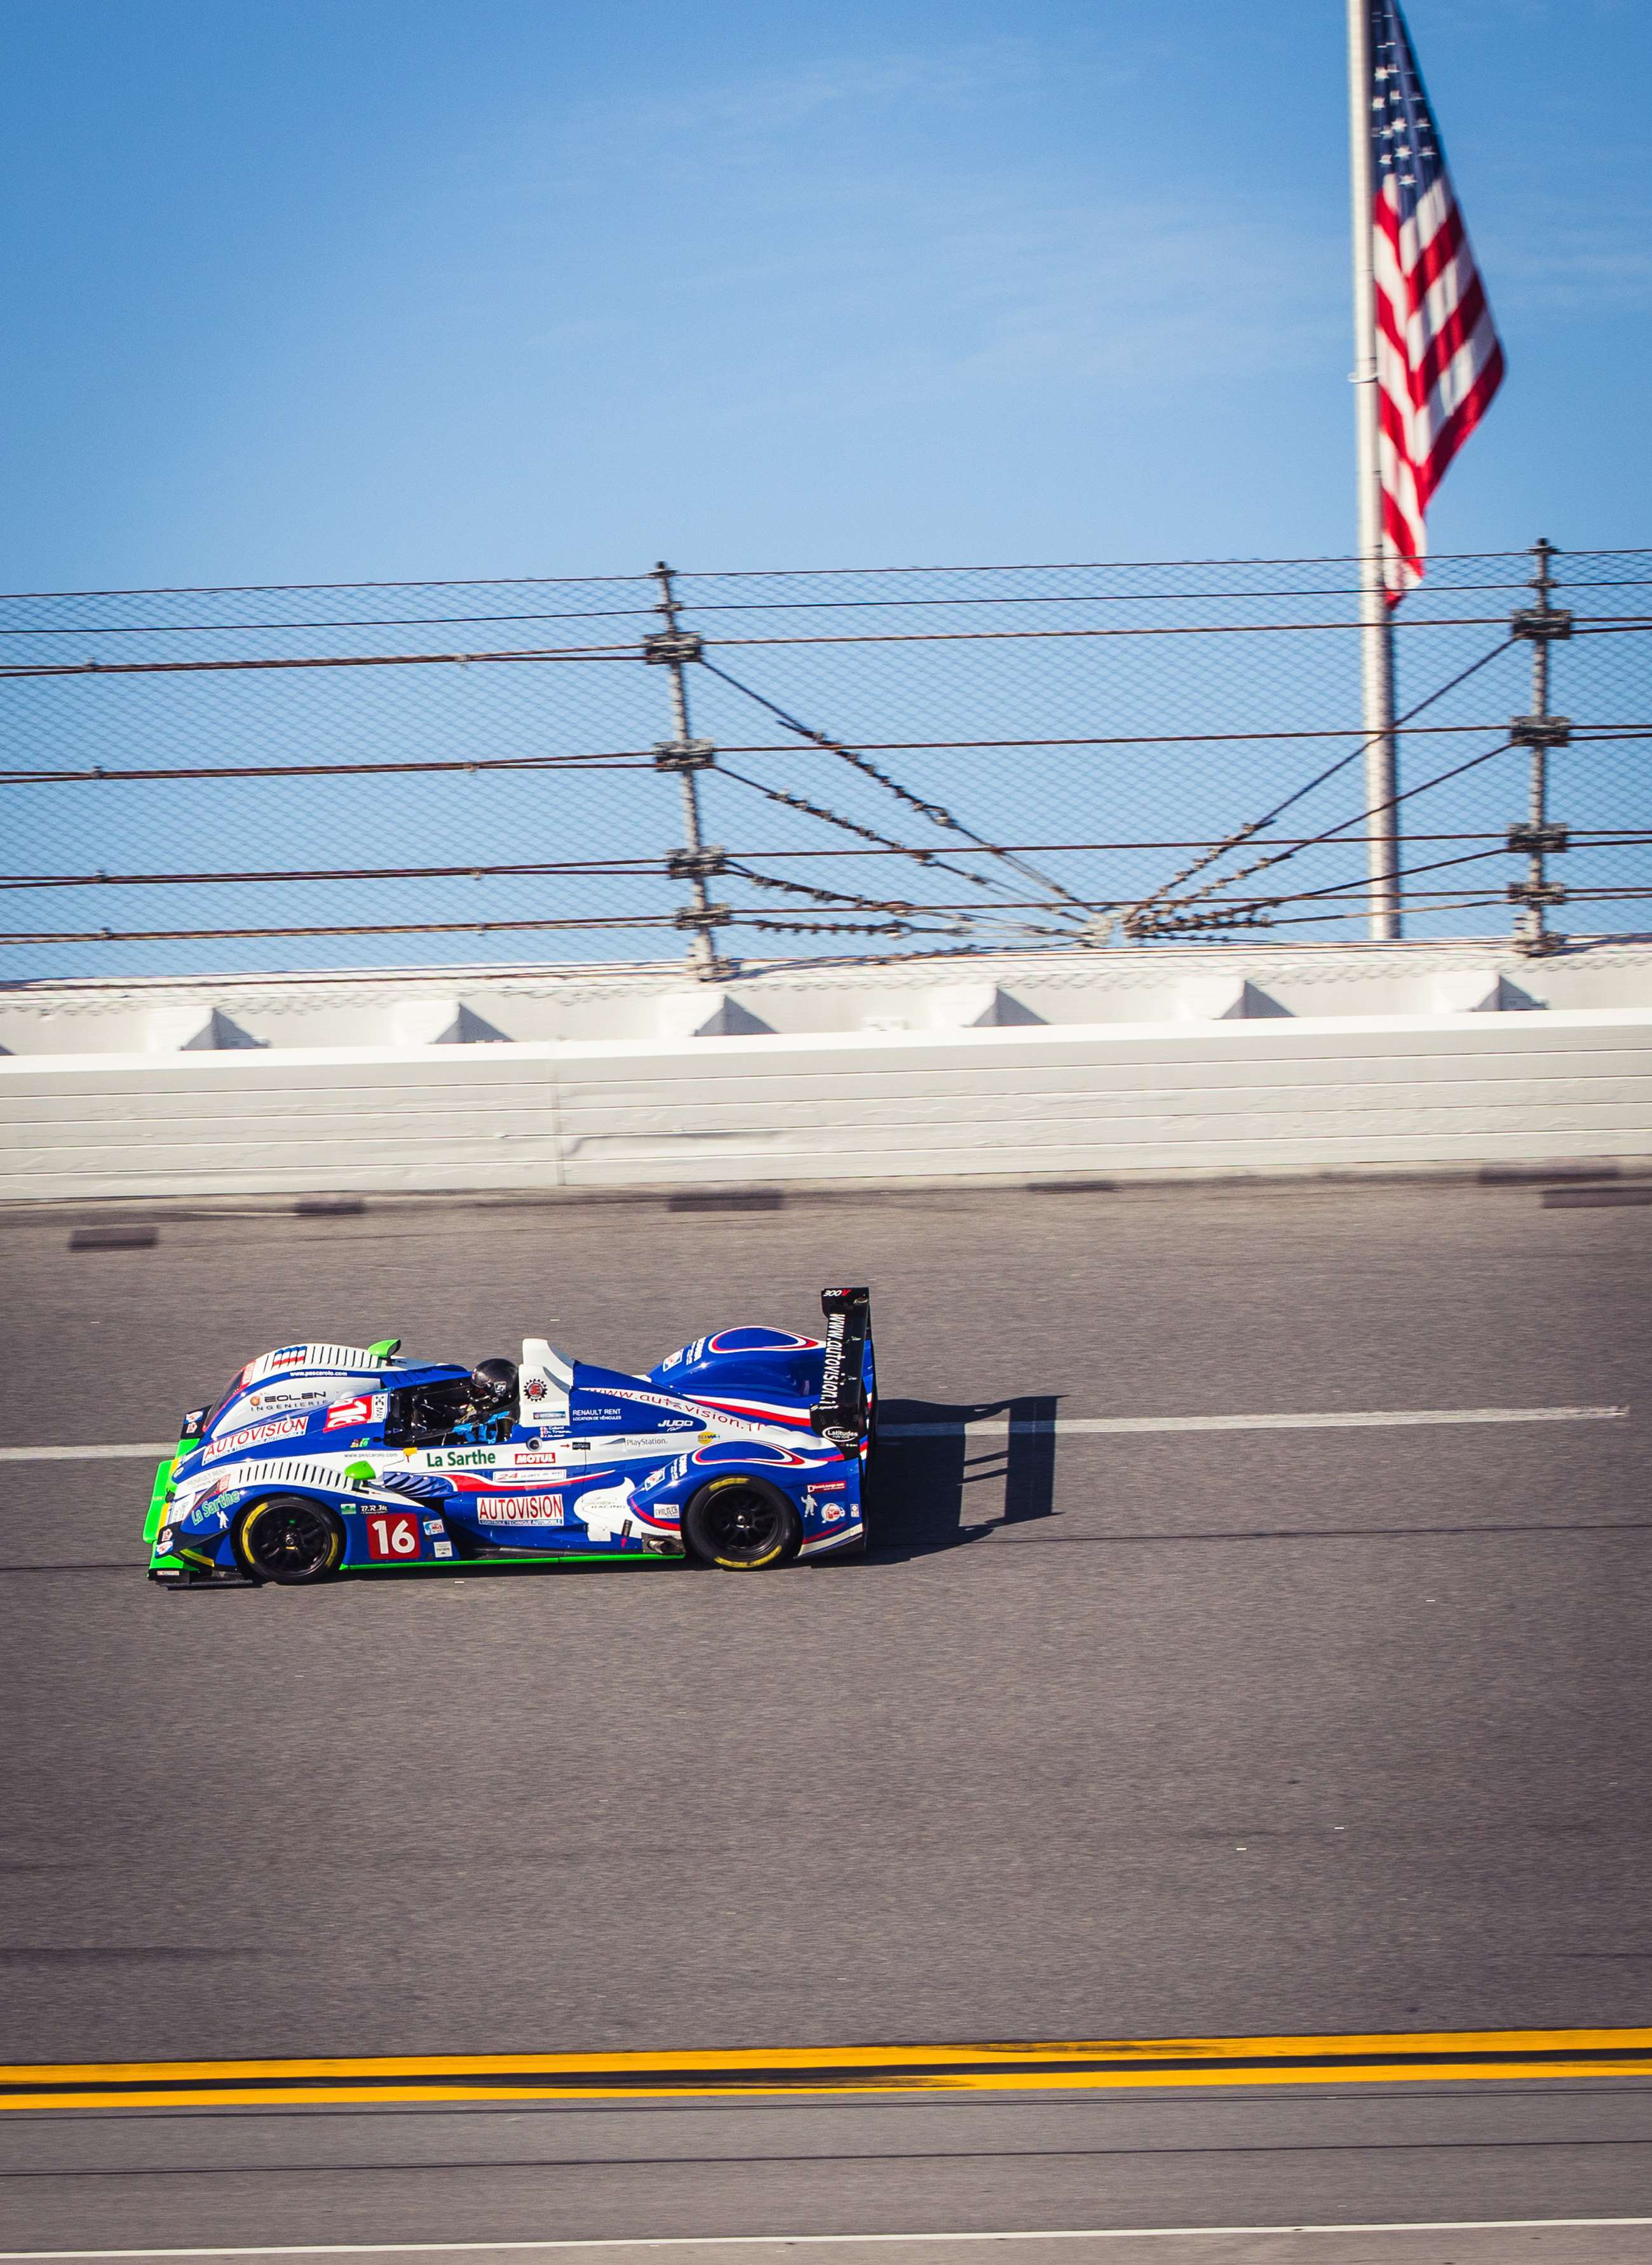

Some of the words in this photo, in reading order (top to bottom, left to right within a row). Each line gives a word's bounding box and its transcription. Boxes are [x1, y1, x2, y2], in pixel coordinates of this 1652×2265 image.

[264, 1391, 326, 1403] EOLEN
[205, 1417, 308, 1459] AUTOVISION
[427, 1453, 443, 1468] La
[447, 1449, 496, 1466] Sarthe
[516, 1453, 555, 1464] MOTUL
[191, 1510, 204, 1525] La
[201, 1491, 241, 1518] Sarthe
[479, 1495, 562, 1520] AUTOVISION
[372, 1519, 415, 1554] 16
